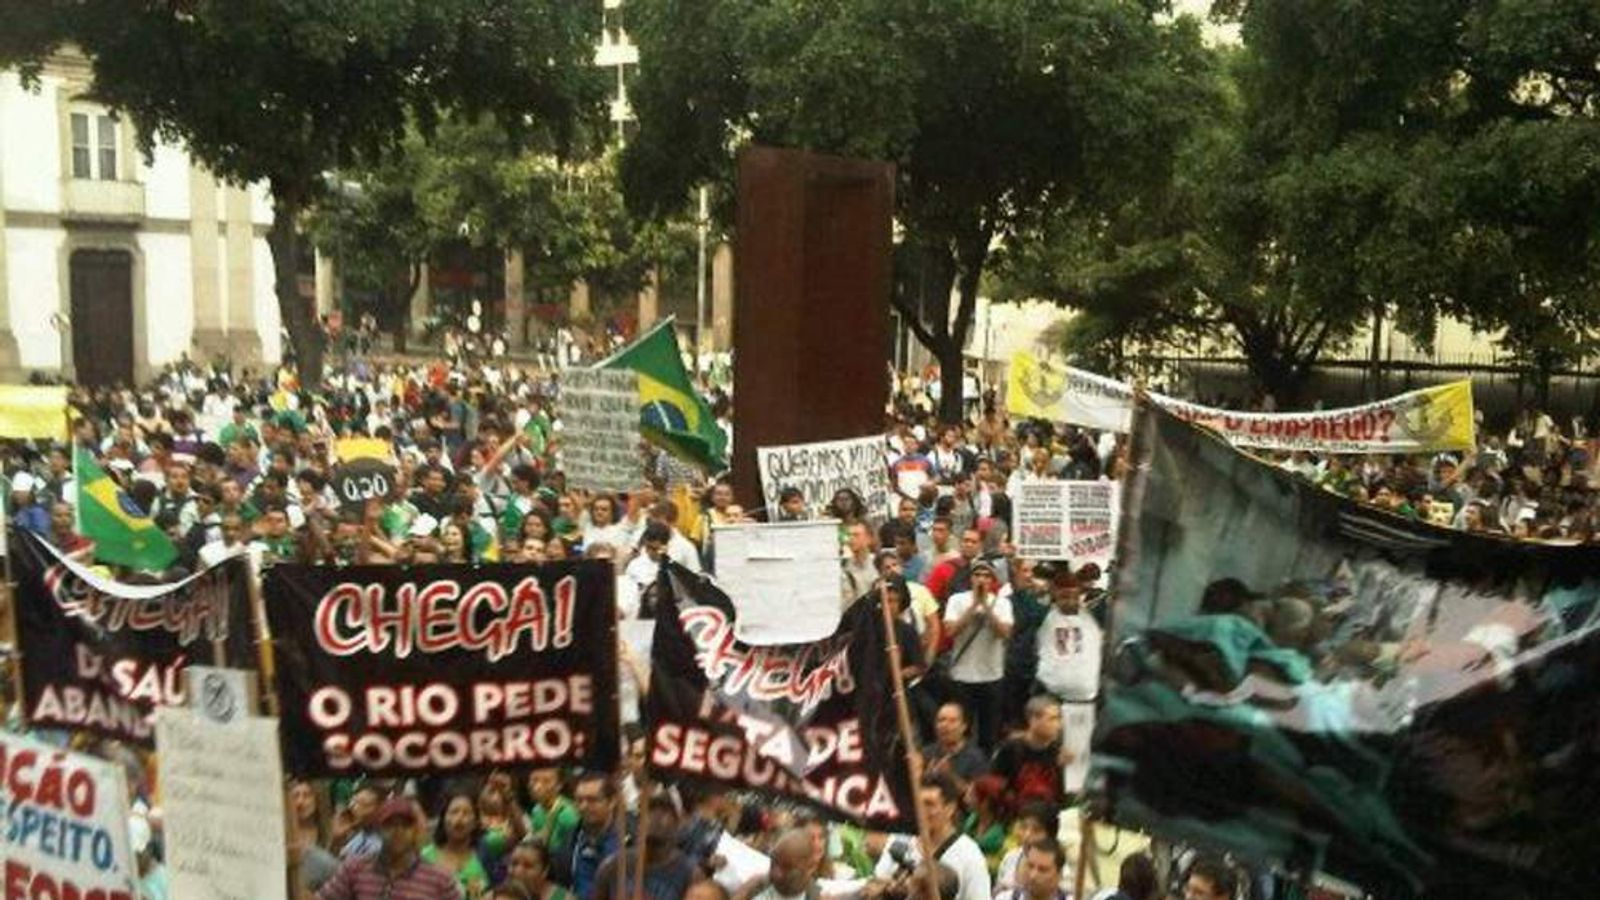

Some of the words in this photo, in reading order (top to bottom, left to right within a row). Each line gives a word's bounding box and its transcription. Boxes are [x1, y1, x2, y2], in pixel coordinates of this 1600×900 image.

[314, 575, 578, 663] CHEGA!
[308, 684, 352, 729] O
[365, 682, 460, 727] RIO
[472, 672, 594, 724] PEDE
[322, 718, 587, 770] SOCORRO:
